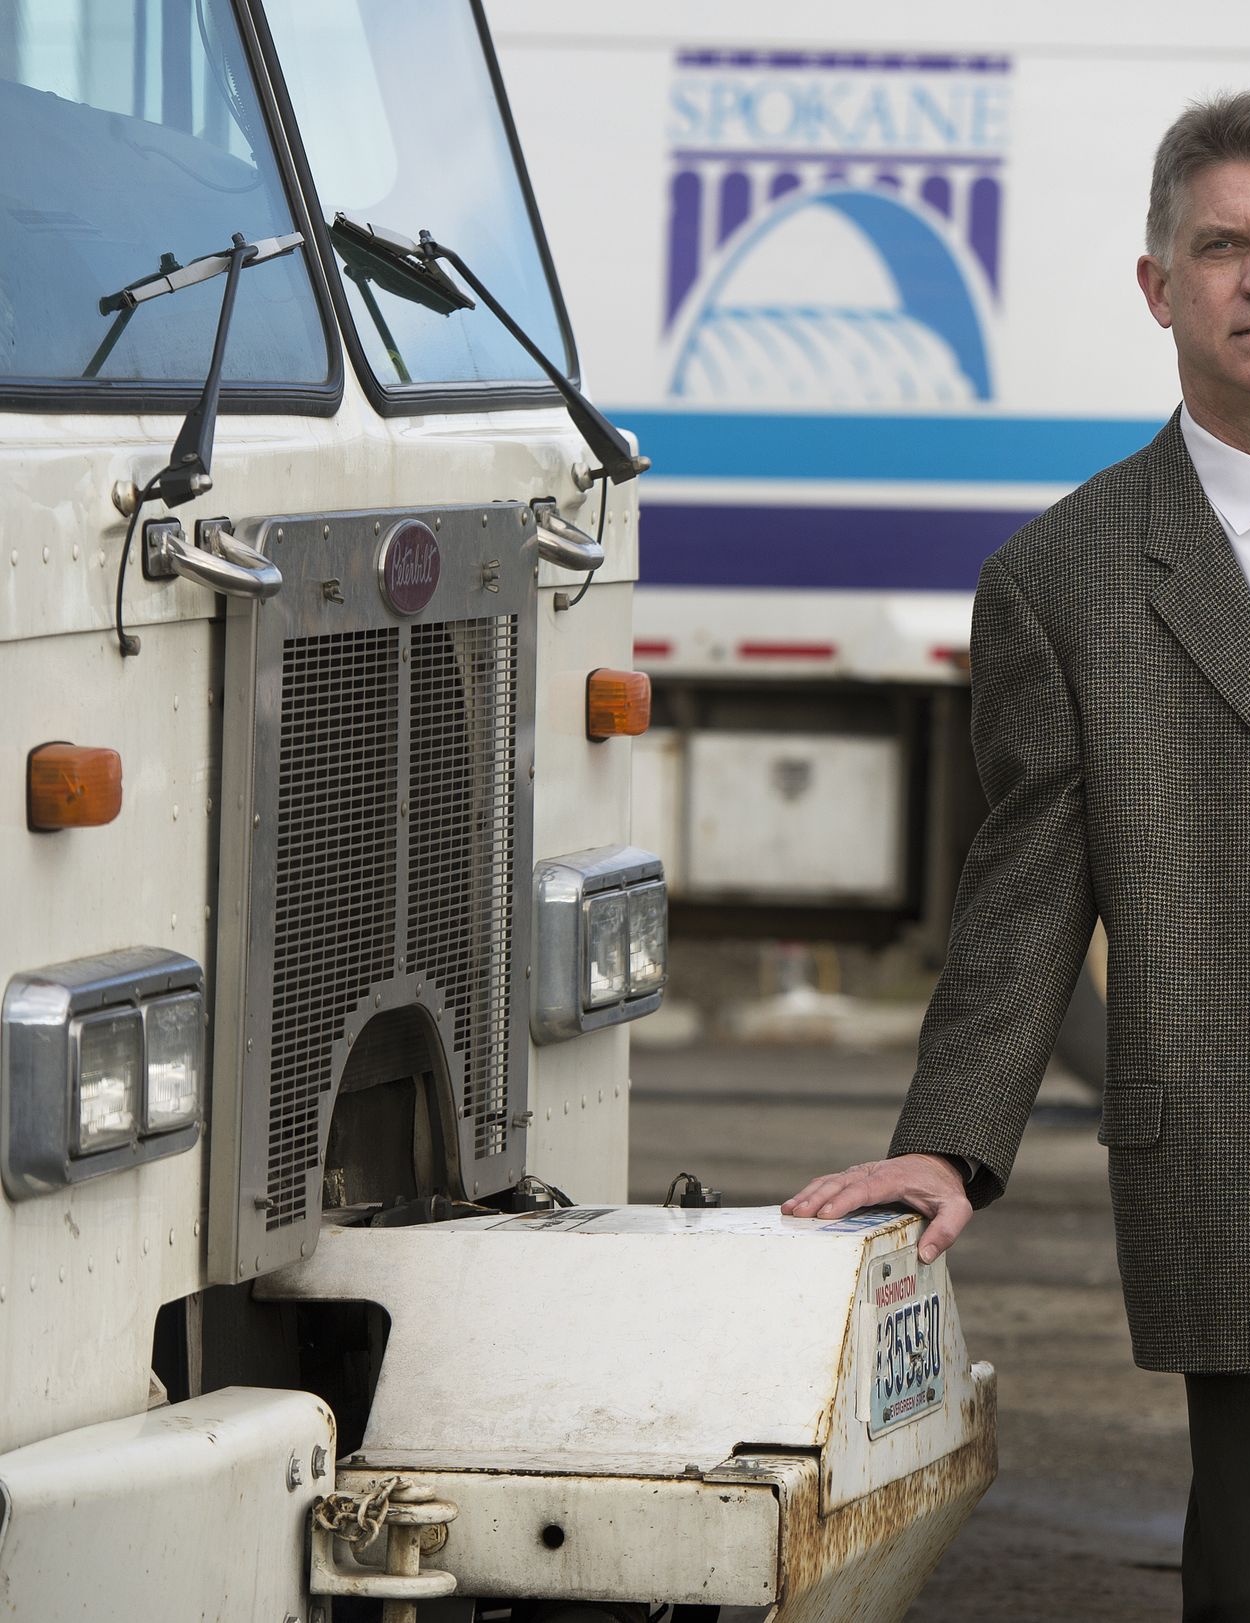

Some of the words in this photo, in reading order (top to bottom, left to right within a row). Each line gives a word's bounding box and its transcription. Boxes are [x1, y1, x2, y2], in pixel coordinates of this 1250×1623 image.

[669, 78, 1014, 148] SPOKANE
[391, 541, 437, 591] Peterbilt
[875, 1273, 917, 1309] WASHINGTON
[889, 1396, 915, 1418] EVERGREEN
